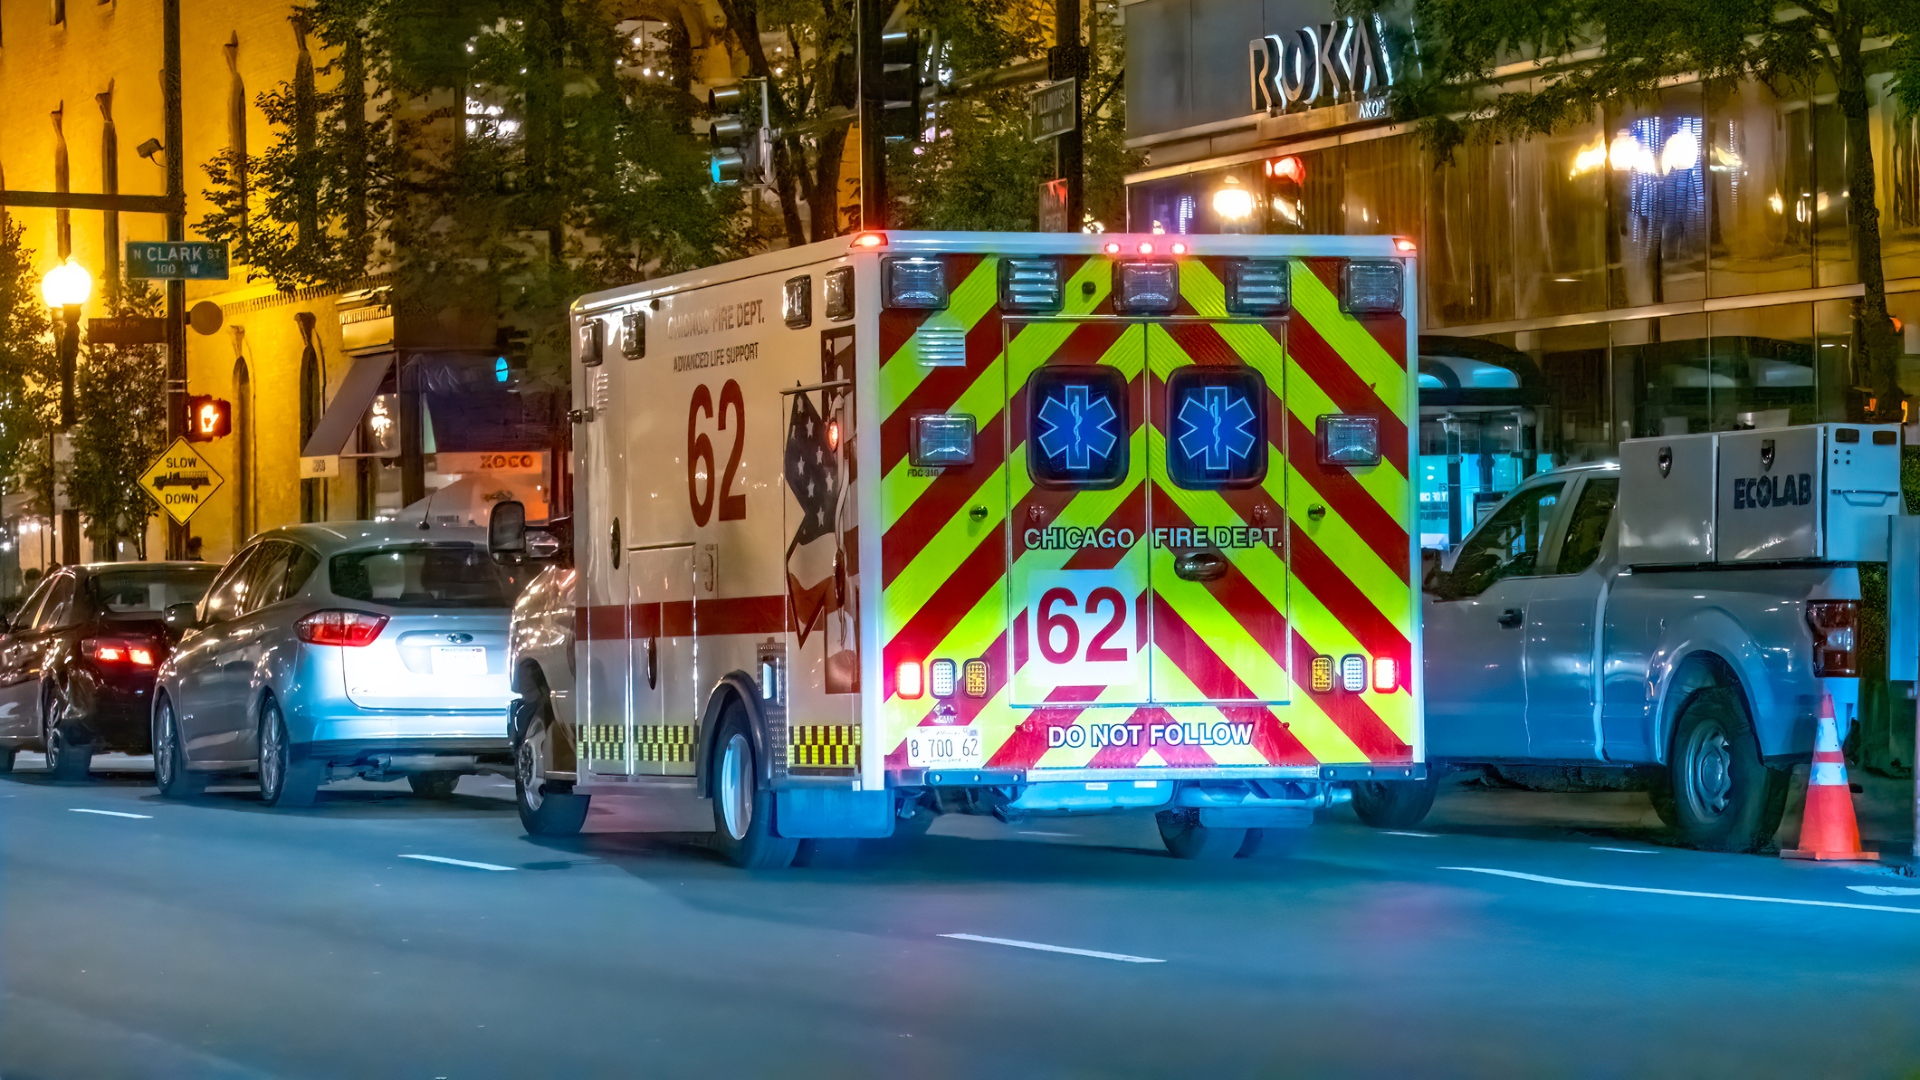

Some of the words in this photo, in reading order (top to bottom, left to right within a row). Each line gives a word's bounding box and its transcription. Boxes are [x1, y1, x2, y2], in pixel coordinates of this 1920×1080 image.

[133, 248, 141, 259] N
[146, 246, 202, 261] CLARK
[206, 248, 221, 259] ST
[156, 264, 176, 274] 100
[190, 264, 199, 274] W
[673, 351, 709, 372] ADVANCED
[710, 348, 725, 367] LIFE
[725, 342, 760, 364] SUPPORT
[165, 457, 198, 469] SLOW
[480, 455, 534, 469] XOCO
[687, 378, 747, 528] 62
[165, 493, 199, 505] DOWN
[1734, 473, 1812, 510] ECOLAB
[1023, 527, 1135, 550] CHICAGO
[1153, 526, 1209, 549] FIRE
[1214, 526, 1283, 549] DEPT.
[1036, 586, 1128, 665] 62
[1047, 724, 1087, 749] DO
[1091, 724, 1145, 748] NOT
[1149, 722, 1254, 747] FOLLOW
[910, 739, 919, 757] 8
[928, 739, 953, 757] 700
[962, 738, 979, 757] 62
